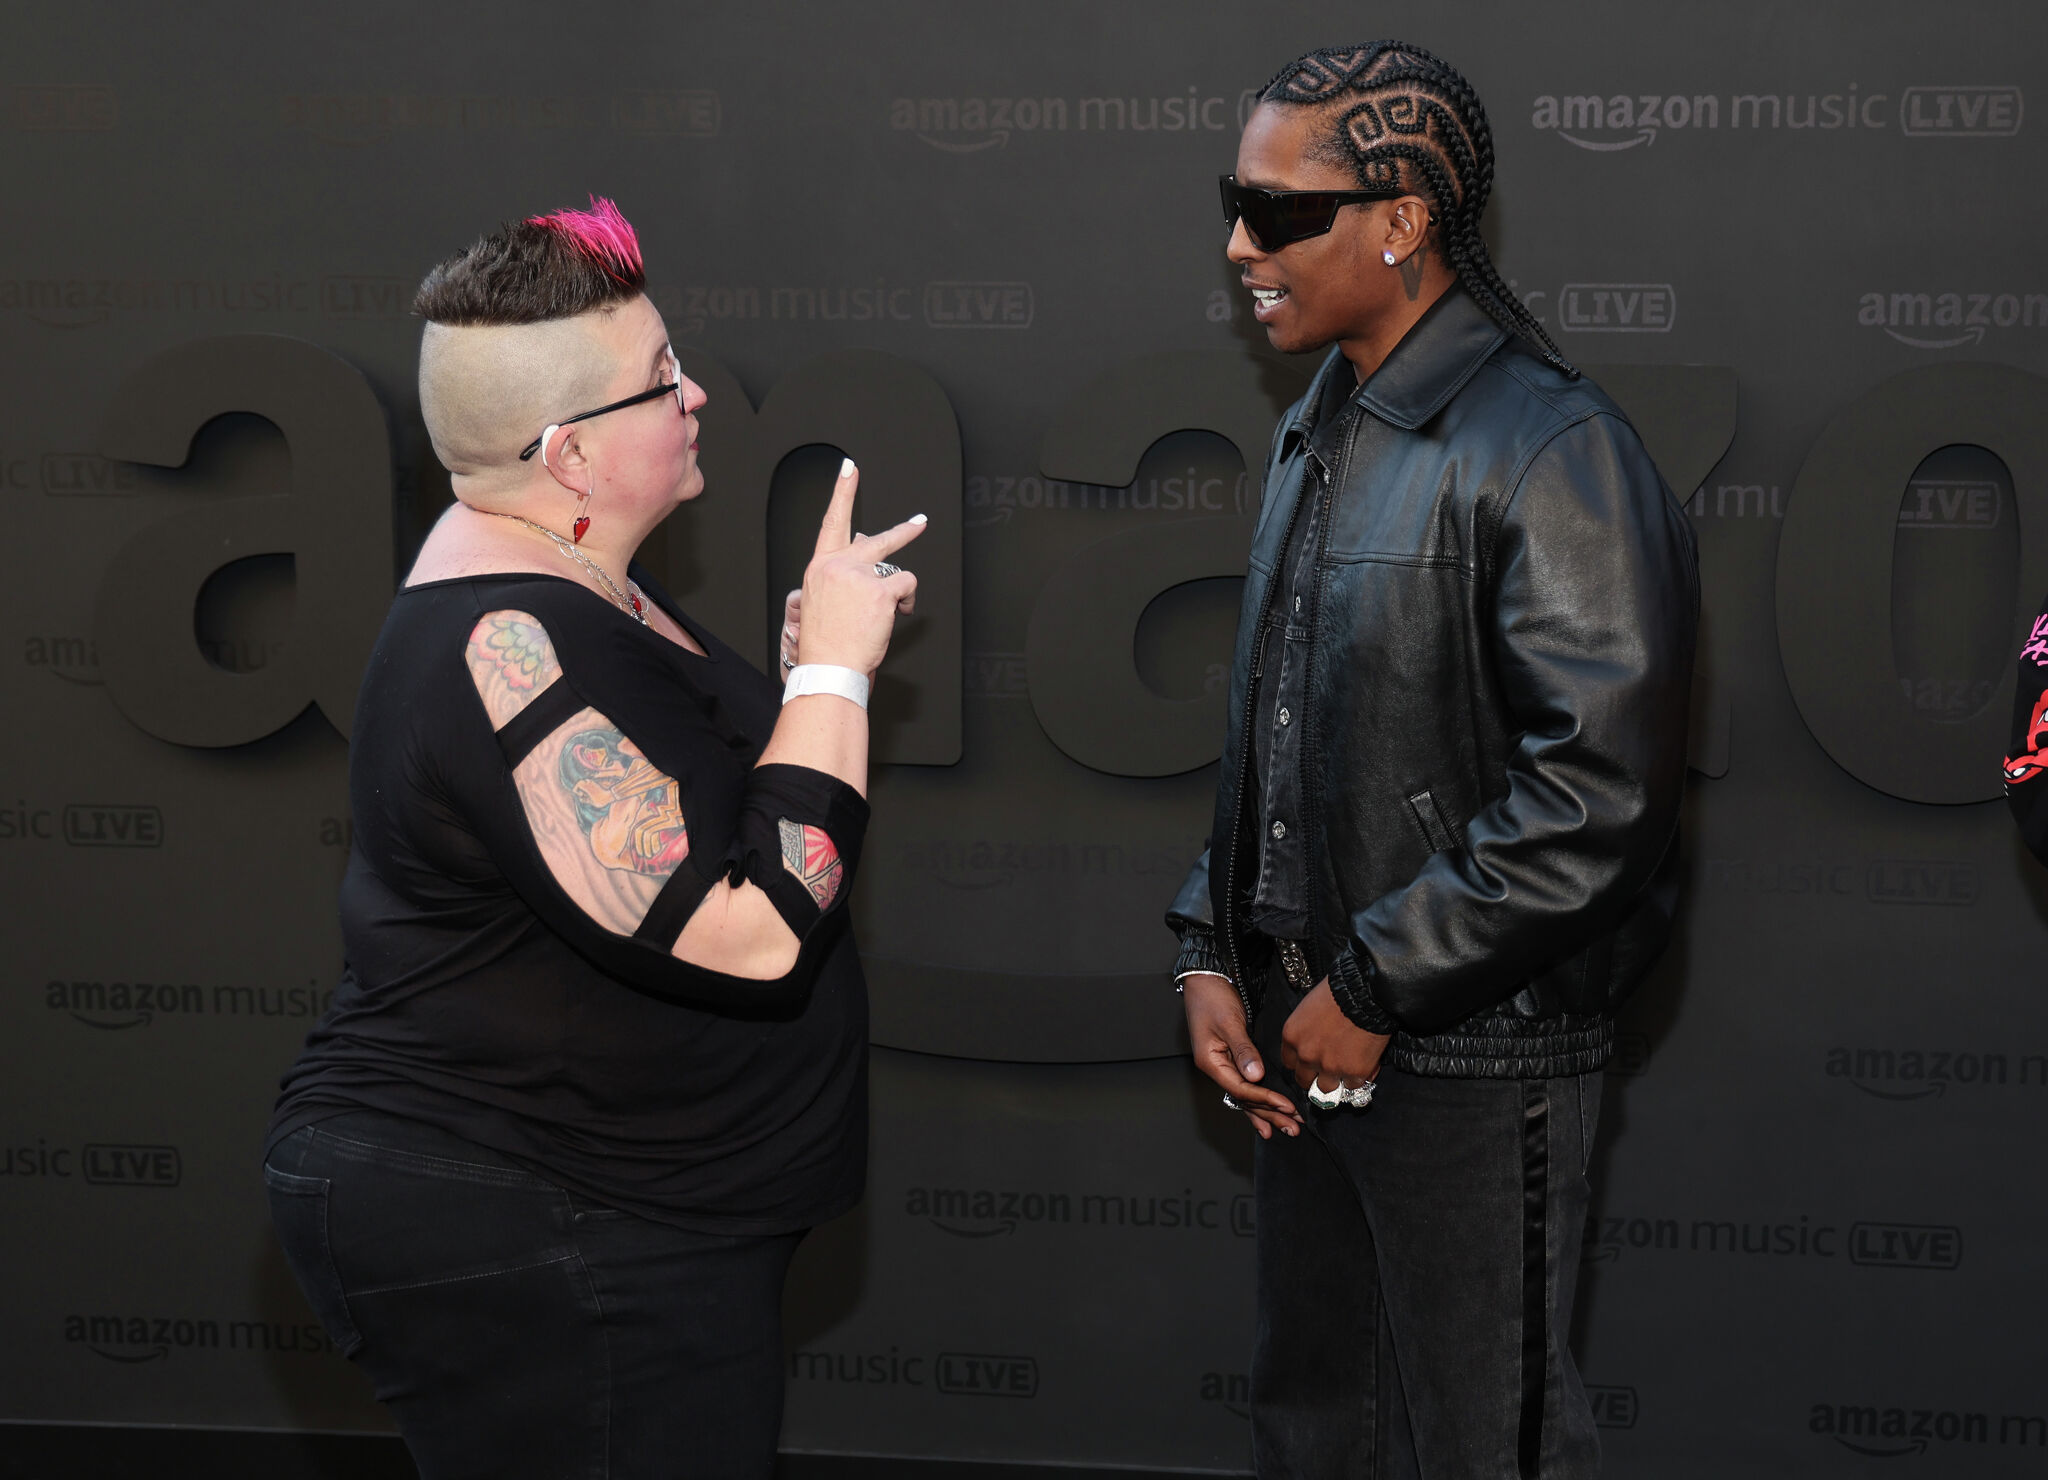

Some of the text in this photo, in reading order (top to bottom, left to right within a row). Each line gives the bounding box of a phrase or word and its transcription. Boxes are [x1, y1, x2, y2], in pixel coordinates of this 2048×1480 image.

[891, 96, 1069, 132] amazon
[1078, 85, 1226, 133] music
[1531, 81, 2015, 131] amazon music LIVE
[169, 274, 309, 312] music
[771, 277, 912, 322] music
[931, 288, 1027, 323] LIVE
[1568, 290, 1667, 325] LIVE
[1858, 291, 2048, 329] amazon
[71, 811, 156, 841] LIVE
[1873, 866, 1973, 900] LIVE
[45, 979, 204, 1014] amazon
[1824, 1046, 2007, 1085] amazon
[90, 1150, 174, 1181] LIVE
[905, 1186, 1070, 1223] amazon
[1082, 1188, 1219, 1230] music
[1690, 1215, 1837, 1258] music
[1856, 1228, 1954, 1264] LIVE
[64, 1314, 218, 1349] amazon
[792, 1345, 1031, 1391] music LIVE
[1808, 1402, 1989, 1444] amazon
